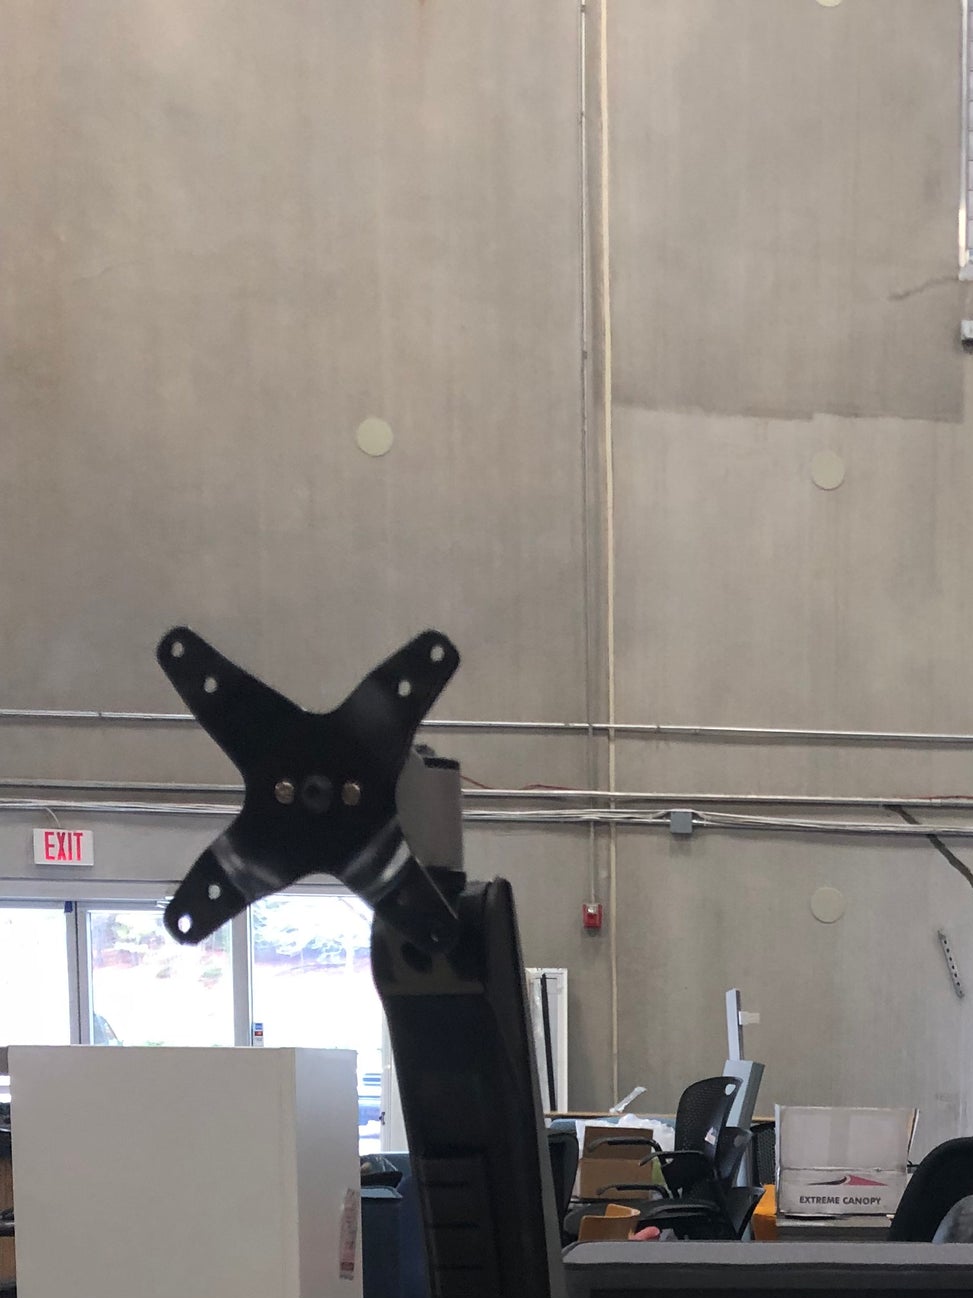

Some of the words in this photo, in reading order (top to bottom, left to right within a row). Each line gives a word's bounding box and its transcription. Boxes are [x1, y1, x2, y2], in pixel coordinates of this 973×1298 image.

[44, 831, 83, 862] EXIT
[799, 1195, 840, 1205] EXTREME
[842, 1196, 882, 1206] CANOPY
